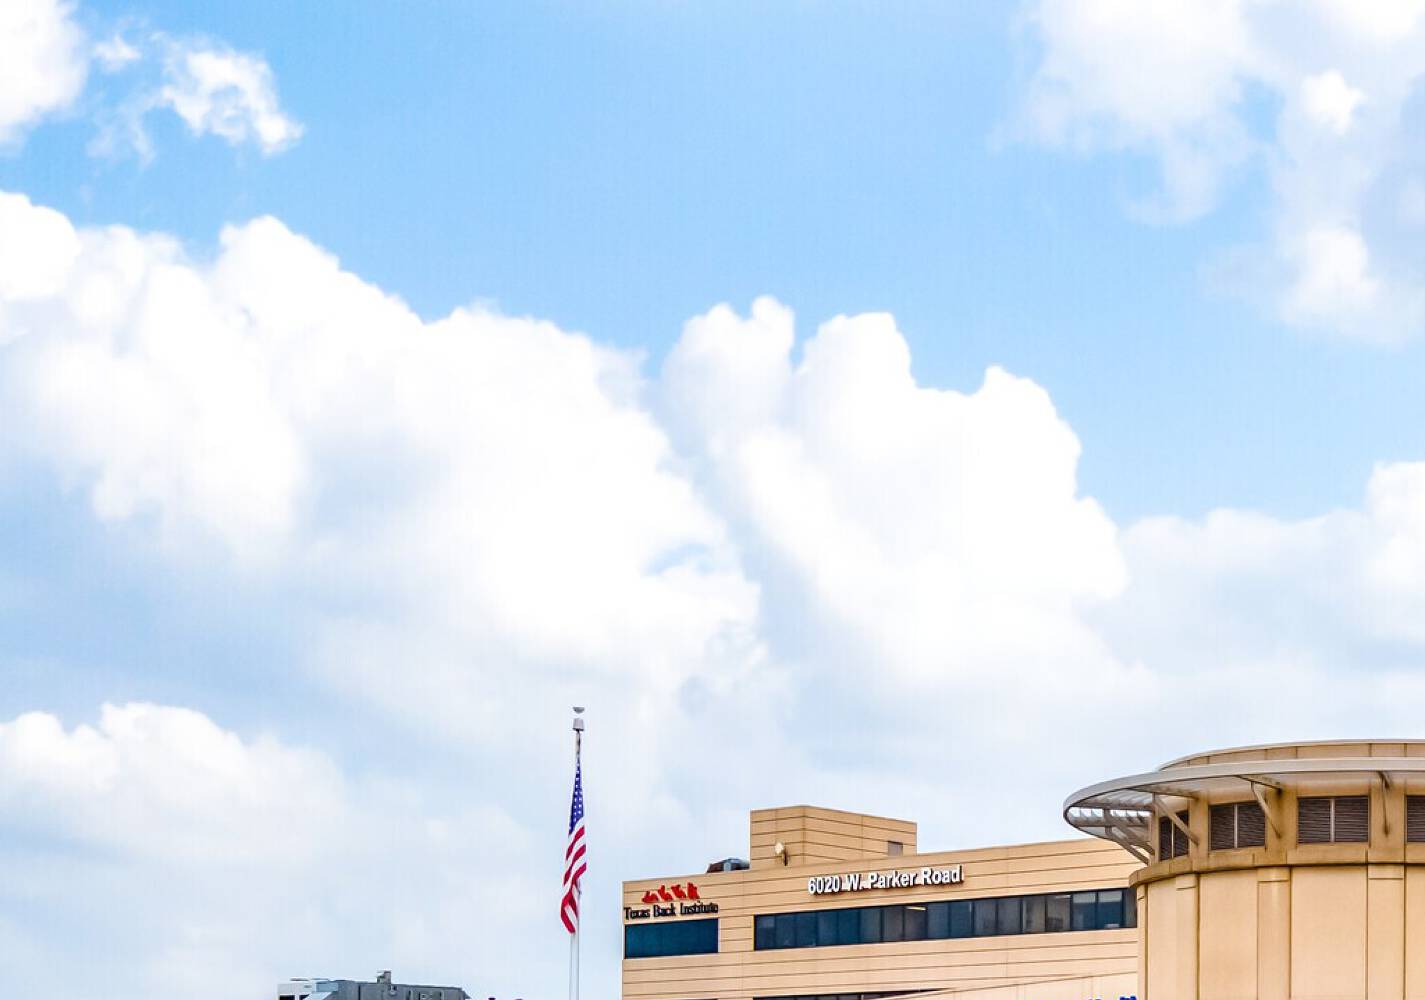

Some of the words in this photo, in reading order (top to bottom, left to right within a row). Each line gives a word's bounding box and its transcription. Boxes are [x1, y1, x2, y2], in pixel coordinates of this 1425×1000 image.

[808, 875, 840, 894] 6020
[846, 873, 864, 891] W.
[869, 870, 917, 889] Parker
[921, 864, 962, 885] Road
[653, 902, 676, 917] Back
